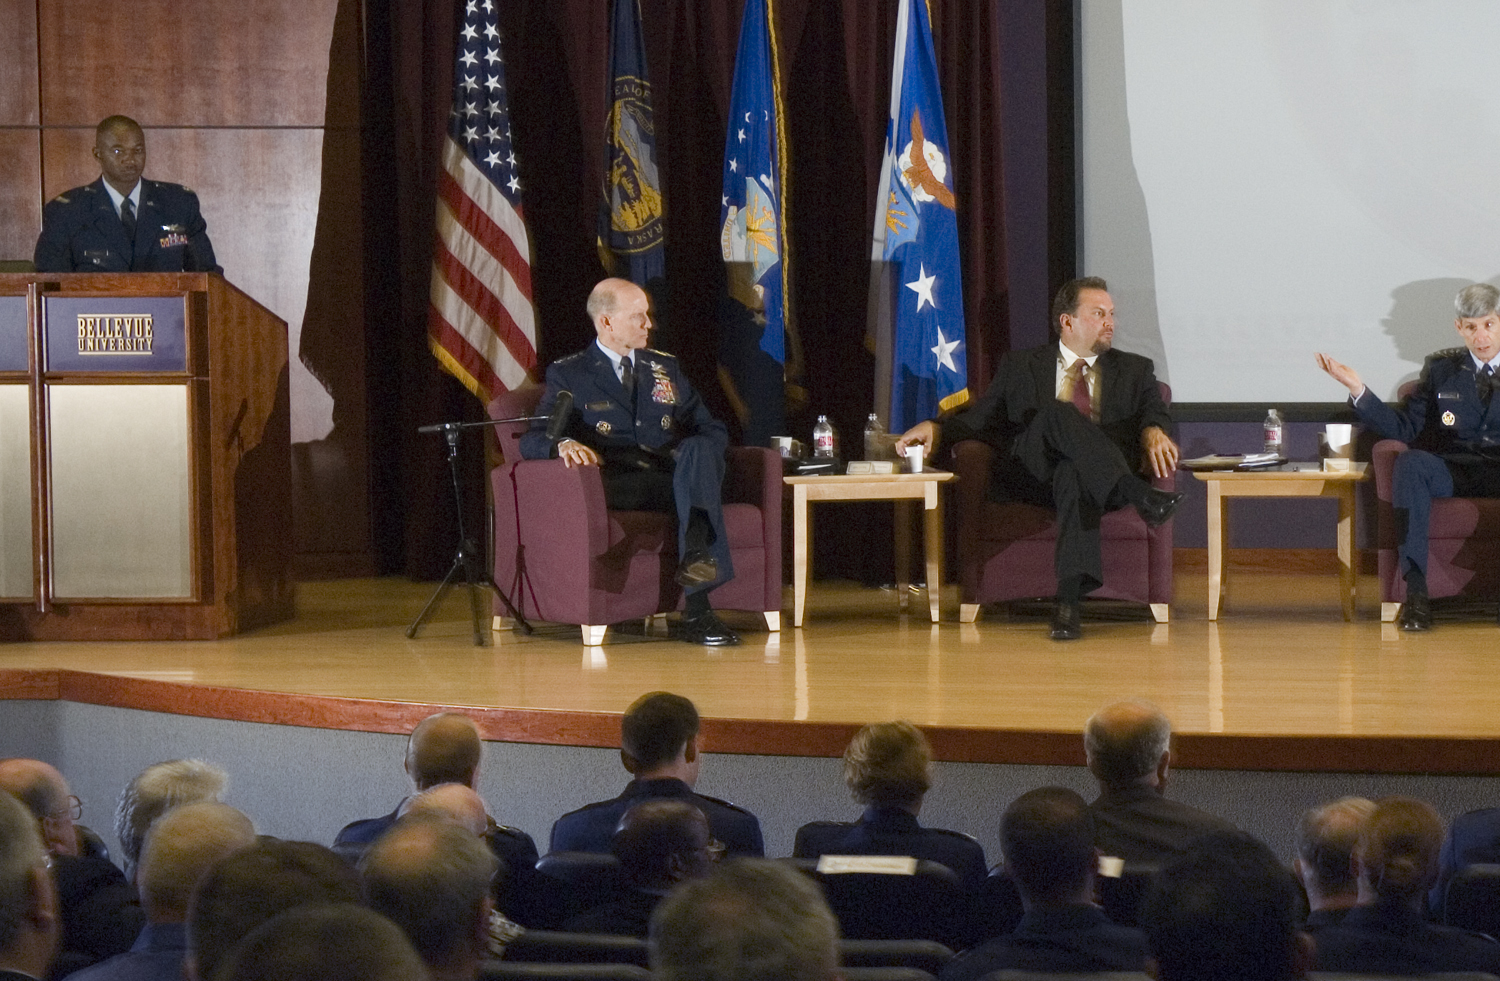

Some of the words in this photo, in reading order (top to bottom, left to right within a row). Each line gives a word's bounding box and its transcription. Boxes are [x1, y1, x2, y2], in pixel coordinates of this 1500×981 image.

[615, 84, 636, 95] EAL
[627, 223, 663, 245] RASKA
[77, 318, 153, 338] BELLEVUE
[78, 338, 153, 351] UNIVERSITY
